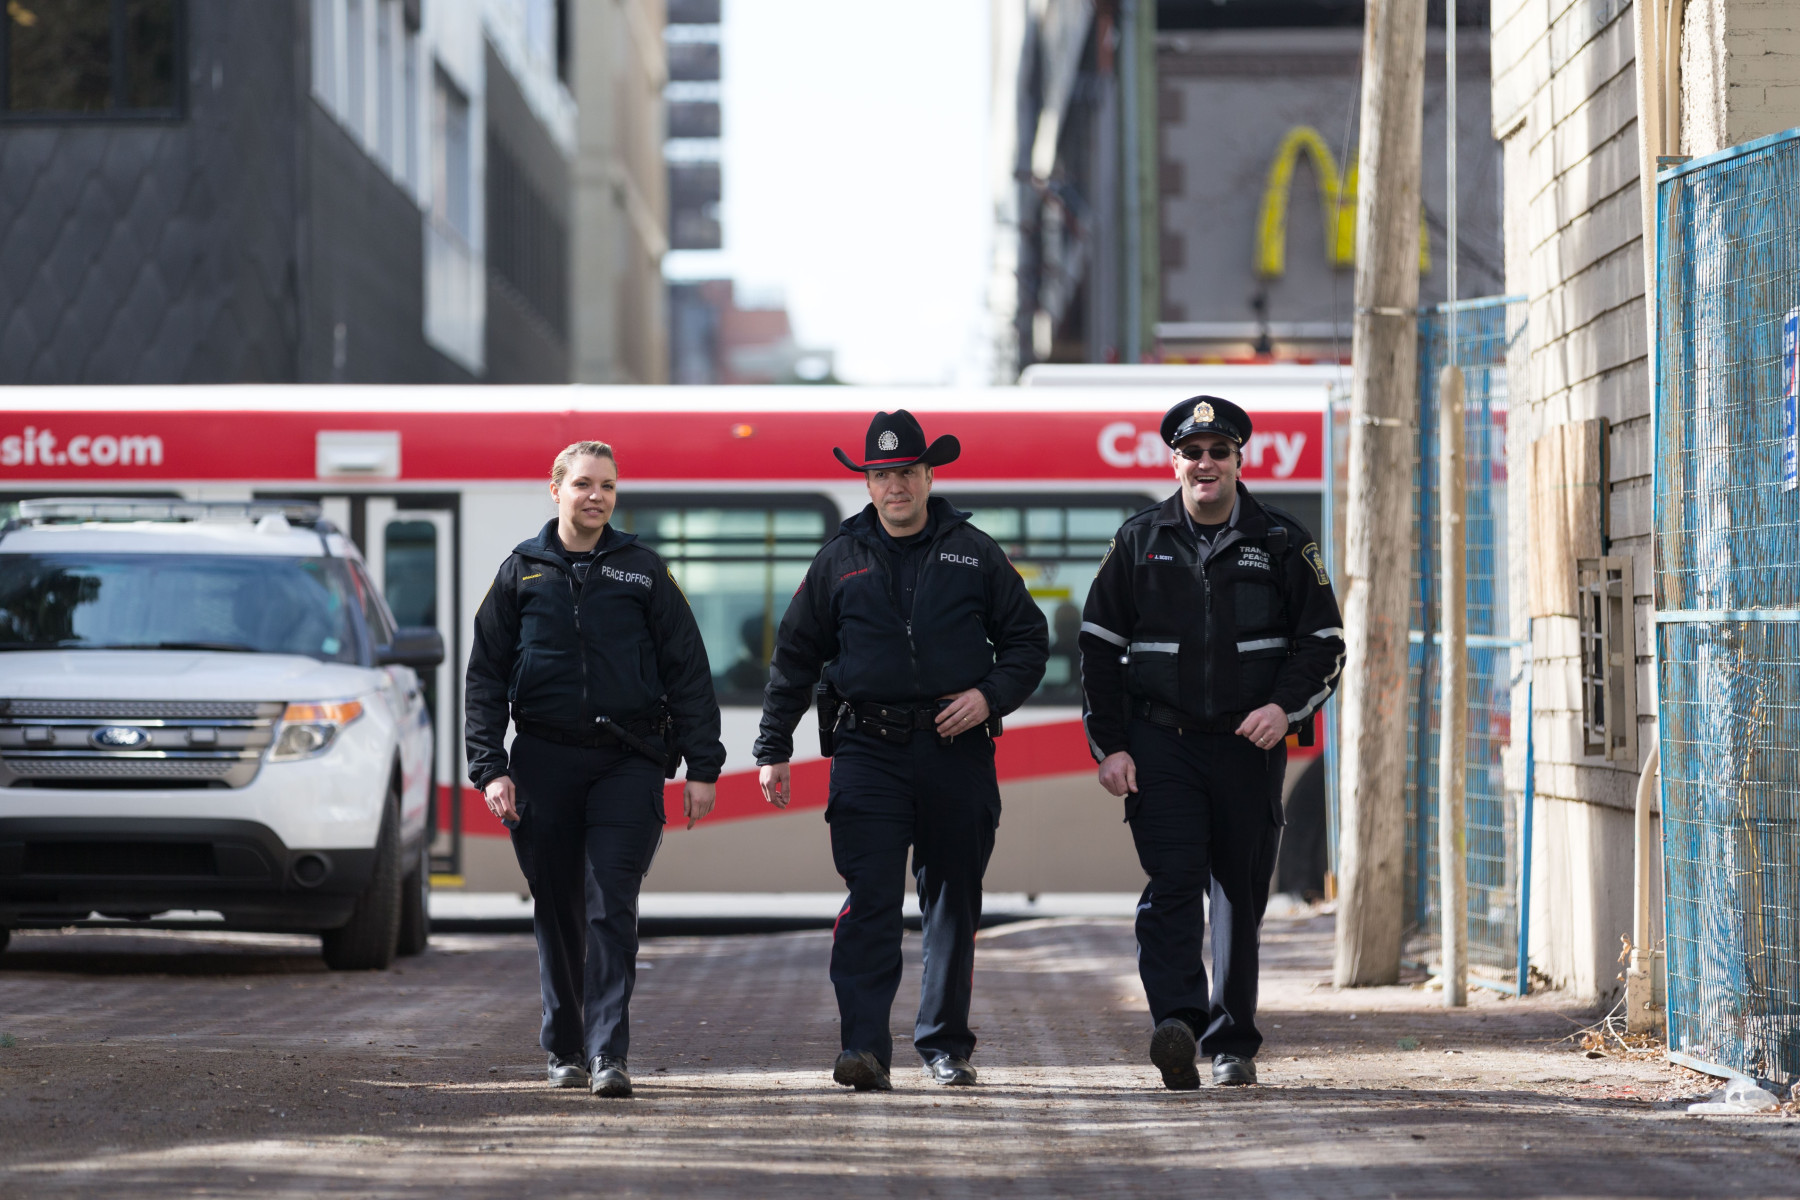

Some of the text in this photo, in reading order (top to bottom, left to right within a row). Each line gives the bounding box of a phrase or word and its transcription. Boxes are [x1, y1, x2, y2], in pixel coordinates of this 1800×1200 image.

[0, 425, 163, 466] sit.com
[1097, 422, 1306, 478] Cary
[940, 552, 979, 567] POLICE
[1237, 559, 1271, 571] OFFICER
[1243, 553, 1269, 563] PEACE
[601, 565, 653, 590] PEACE OFFICER
